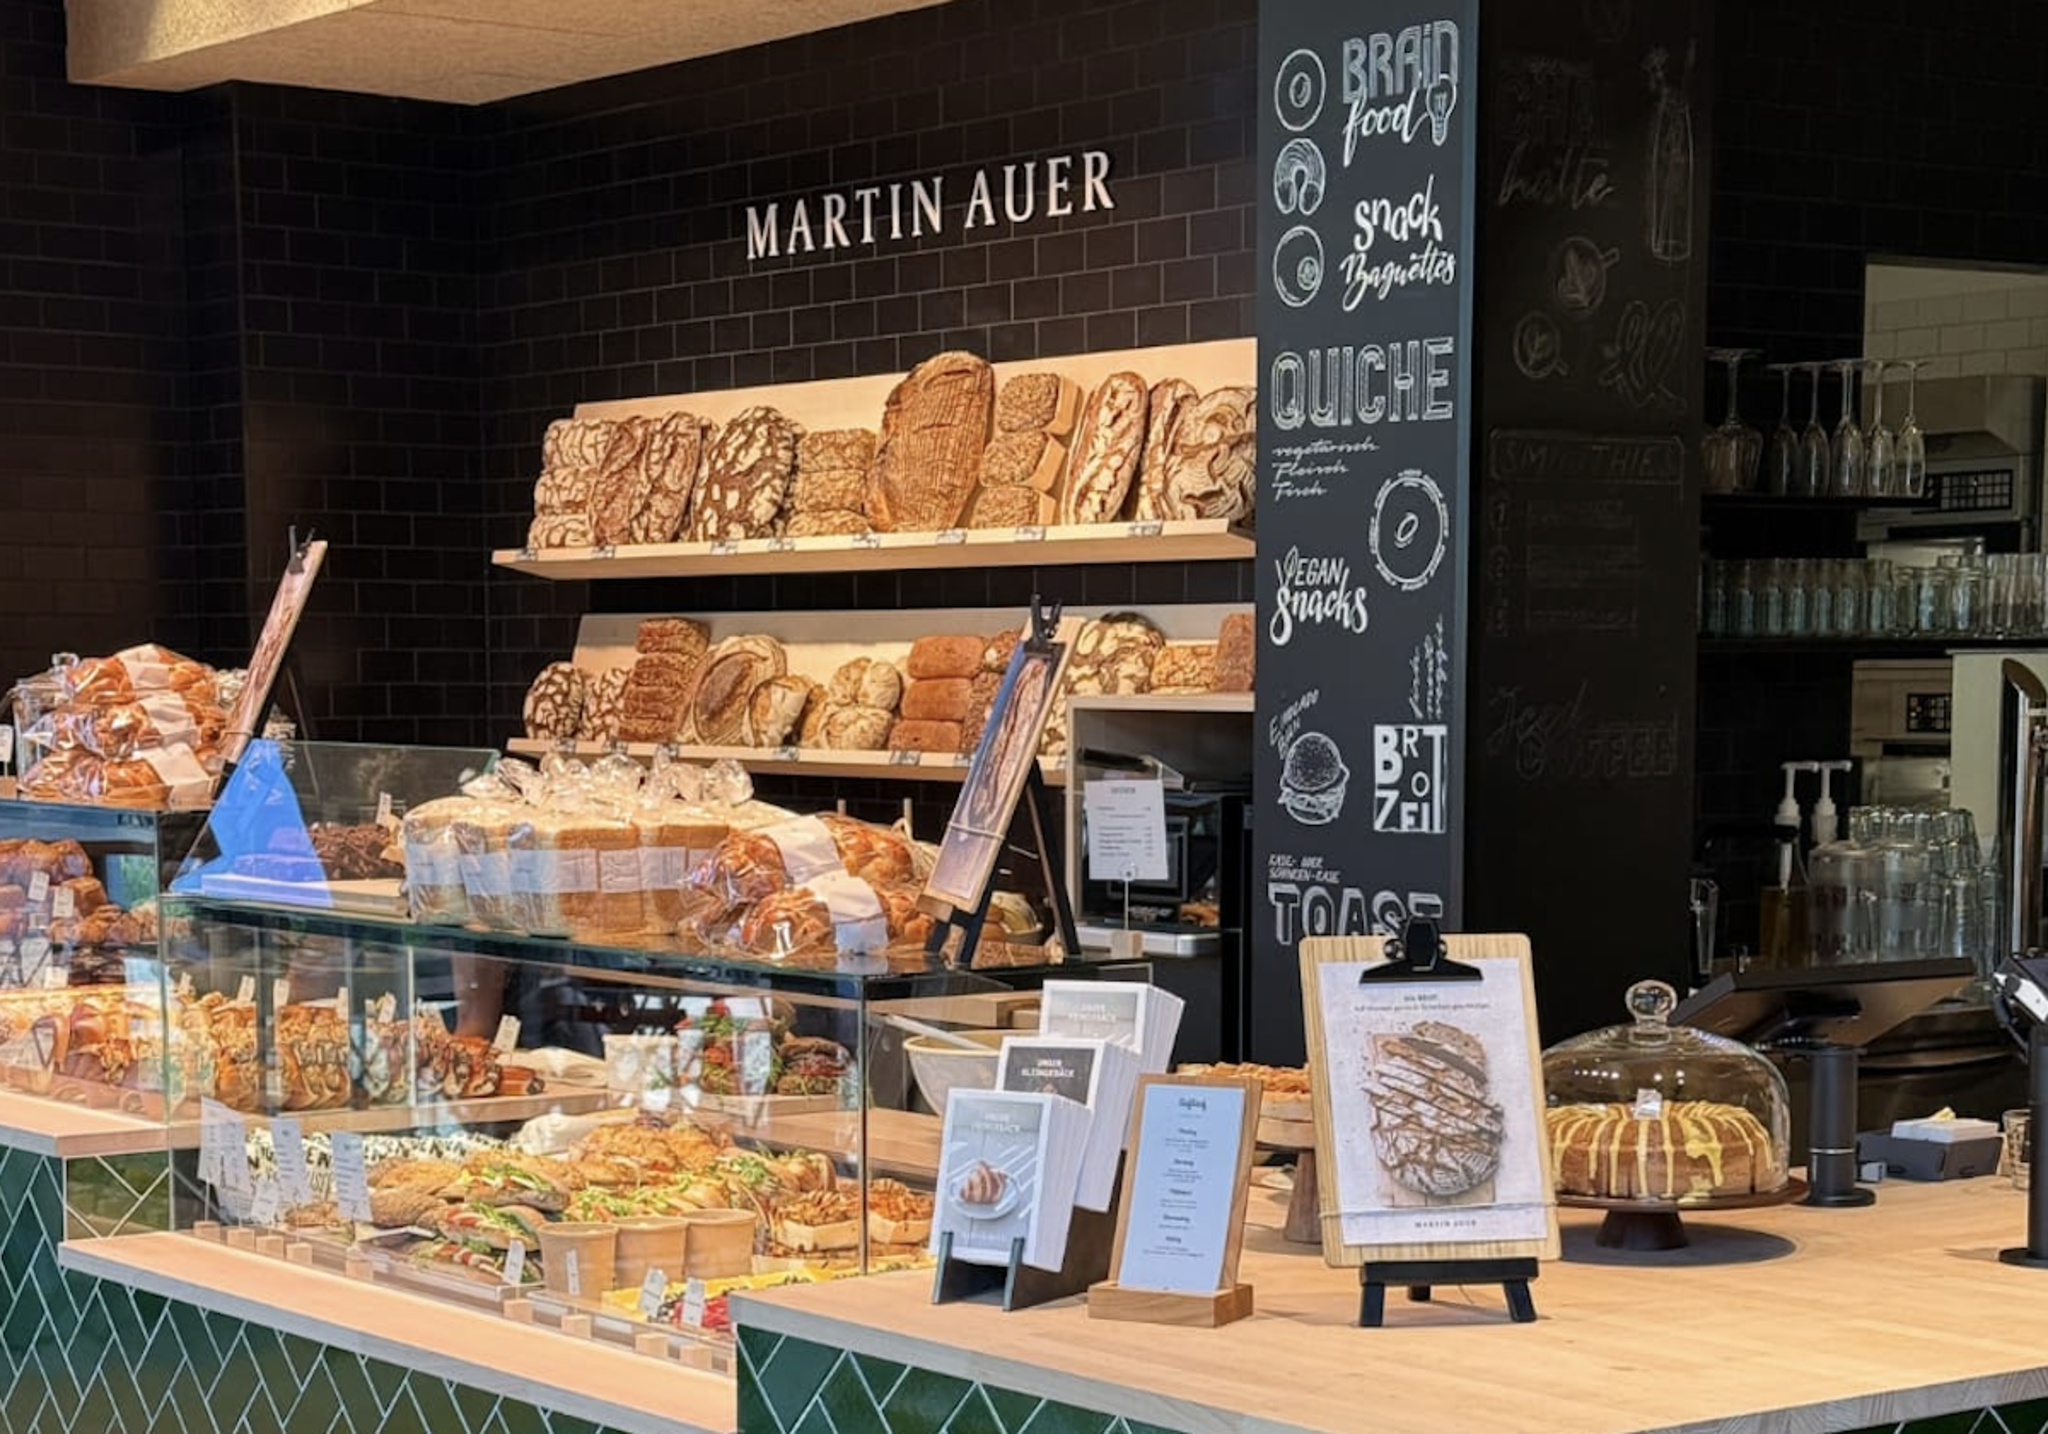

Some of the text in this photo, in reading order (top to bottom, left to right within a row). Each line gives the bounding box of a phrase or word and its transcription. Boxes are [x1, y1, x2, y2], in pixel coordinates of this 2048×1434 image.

[1342, 85, 1429, 168] food
[745, 150, 1115, 260] MARTIN AUER
[1339, 239, 1456, 312] Baguettes
[1270, 336, 1454, 430] QUICHE
[1271, 459, 1350, 483] Fleisch
[1271, 480, 1328, 502] Fisch
[1274, 546, 1345, 588] VEGAN
